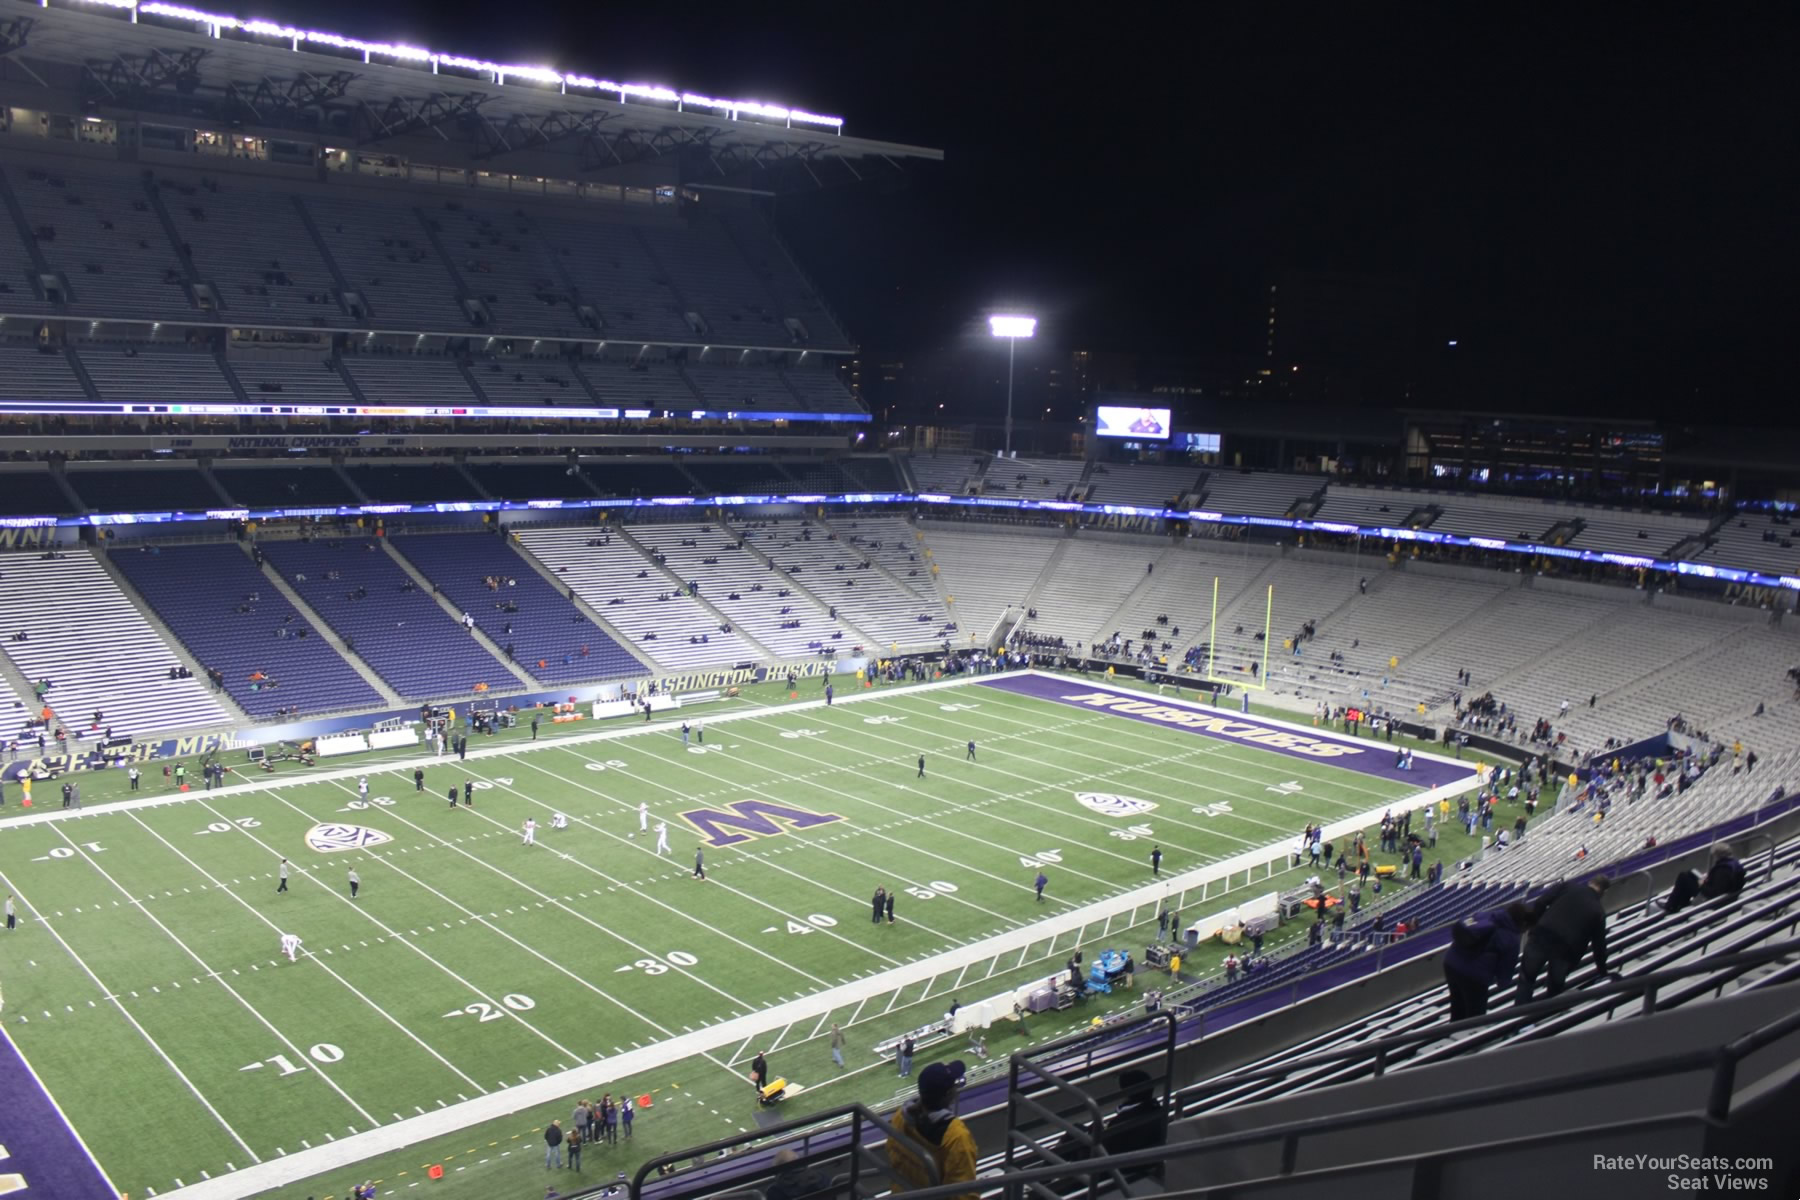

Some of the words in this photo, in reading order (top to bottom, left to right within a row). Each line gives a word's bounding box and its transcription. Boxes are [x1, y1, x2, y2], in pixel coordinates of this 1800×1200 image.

[228, 437, 288, 448] NATIONAL
[291, 437, 361, 447] CHAMPIONS
[636, 669, 758, 697] WASHINGTON
[765, 660, 838, 681] HUSKIES
[1060, 692, 1365, 757] HUSKIES
[175, 731, 237, 756] MEN
[1265, 781, 1303, 795] 10
[1192, 802, 1234, 817] 20
[1109, 824, 1154, 841] 30
[1019, 850, 1062, 868] 40
[904, 880, 959, 900] 50
[787, 914, 838, 935] 40
[634, 951, 698, 975] 30
[464, 993, 536, 1022] 20
[265, 1043, 345, 1076] 10
